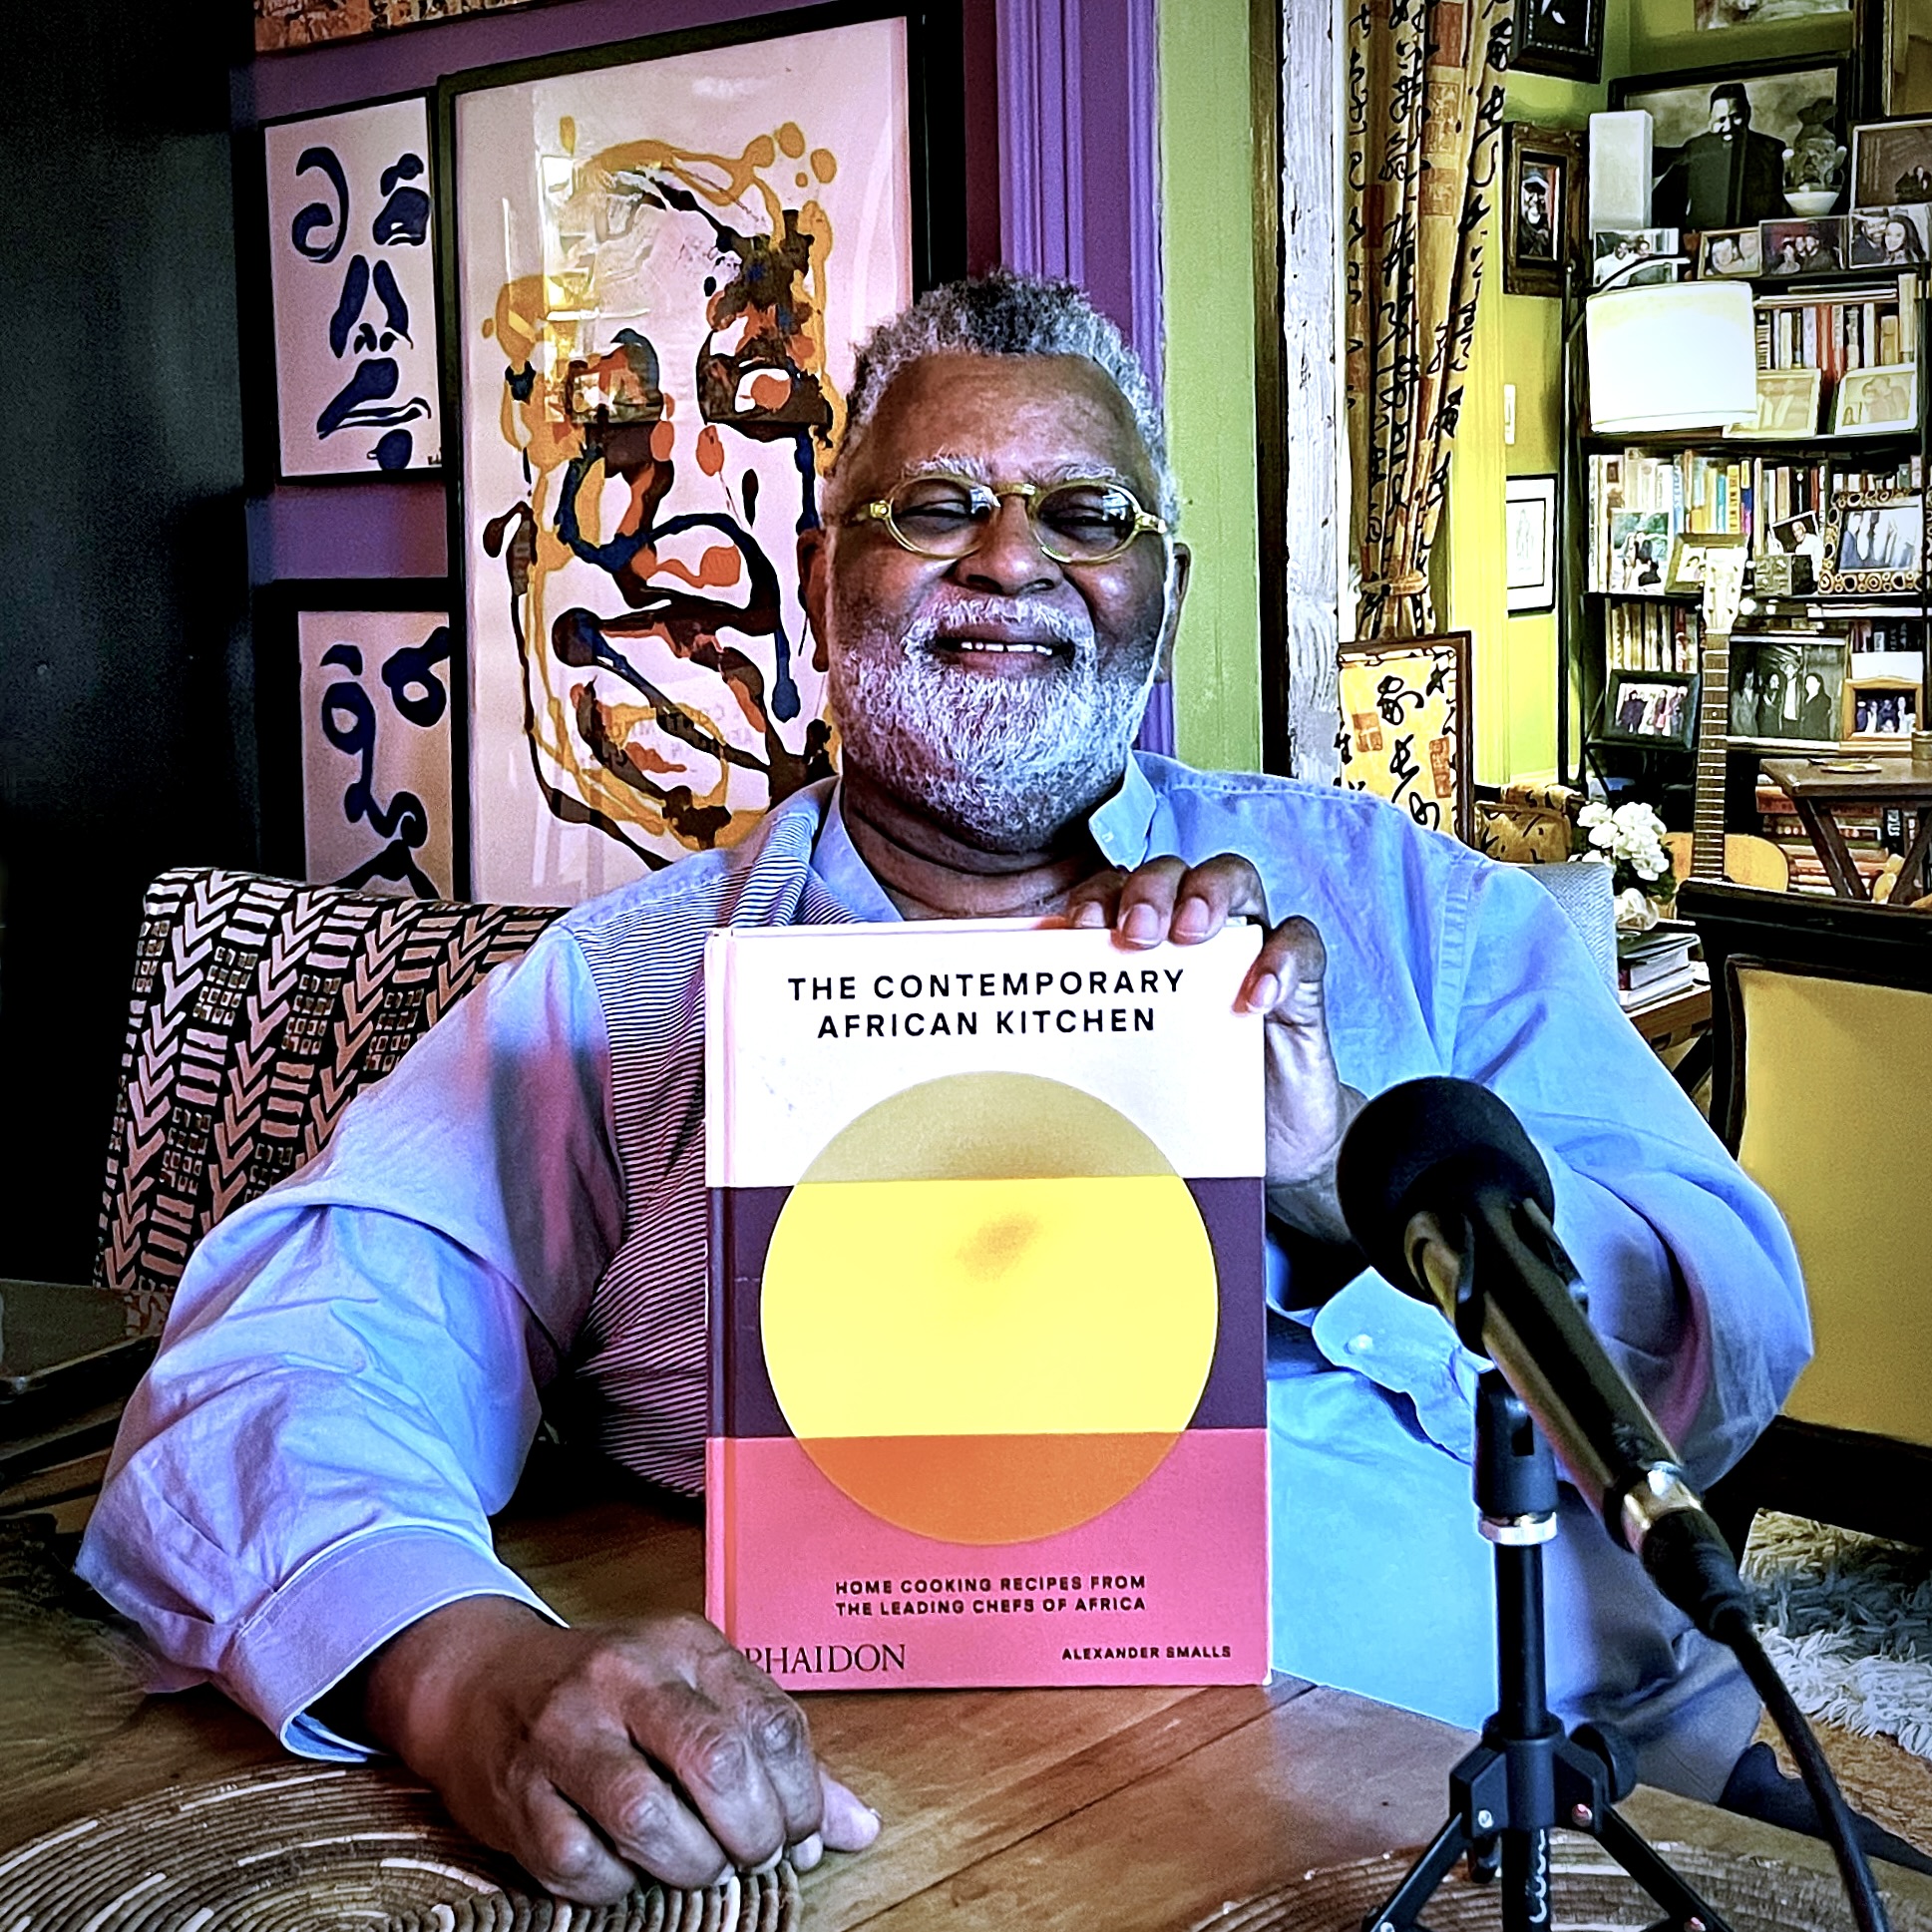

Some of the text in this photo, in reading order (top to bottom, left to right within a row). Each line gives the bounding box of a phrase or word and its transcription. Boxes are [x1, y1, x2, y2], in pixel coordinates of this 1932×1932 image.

[787, 967, 1184, 1001] THE CONTEMPORARY
[817, 1006, 1154, 1039] AFRICAN KITCHEN
[835, 1574, 1145, 1596] HOME COOKING RECIPES FROM
[835, 1595, 1146, 1617] THE LEADING CHEFS OF AFRICA
[744, 1643, 906, 1675] PHAIDON
[1061, 1645, 1231, 1662] ALEXANDER SMALLS
